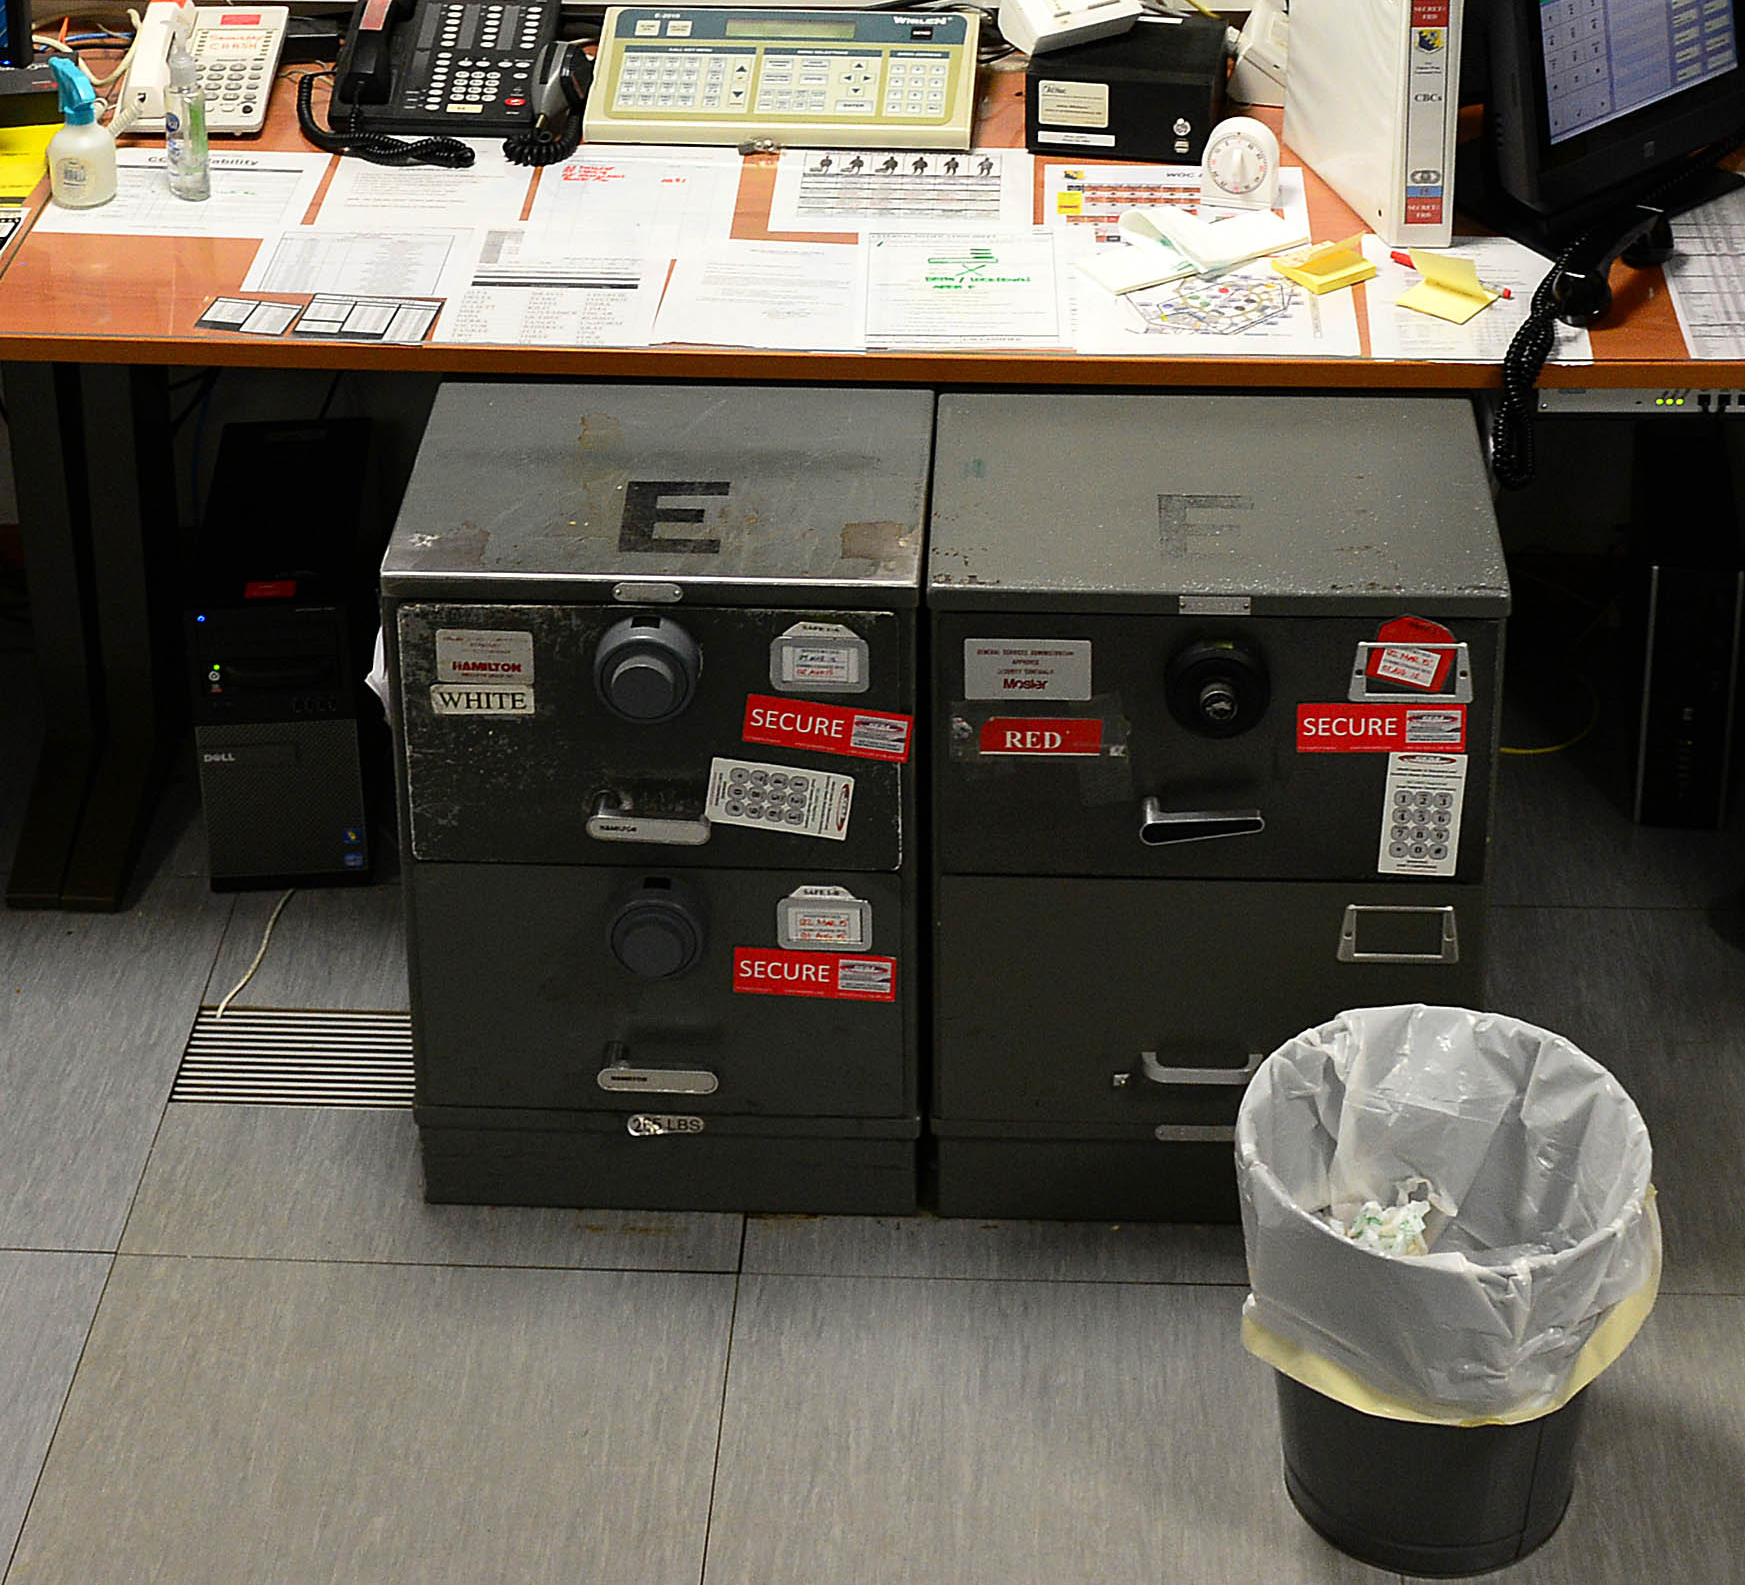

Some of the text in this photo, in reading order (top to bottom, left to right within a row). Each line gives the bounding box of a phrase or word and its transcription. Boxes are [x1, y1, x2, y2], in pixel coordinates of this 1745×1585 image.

[1414, 93, 1443, 103] CBCs
[617, 479, 732, 555] E
[1157, 493, 1256, 564] E
[451, 661, 523, 673] HAMILTON
[438, 691, 527, 710] WHITE
[749, 708, 846, 739] SECURE
[1302, 717, 1399, 736] SECURE
[1004, 730, 1062, 749] RED
[203, 751, 237, 763] DELL
[739, 960, 831, 983] SECURE
[666, 1117, 702, 1131] LBS
